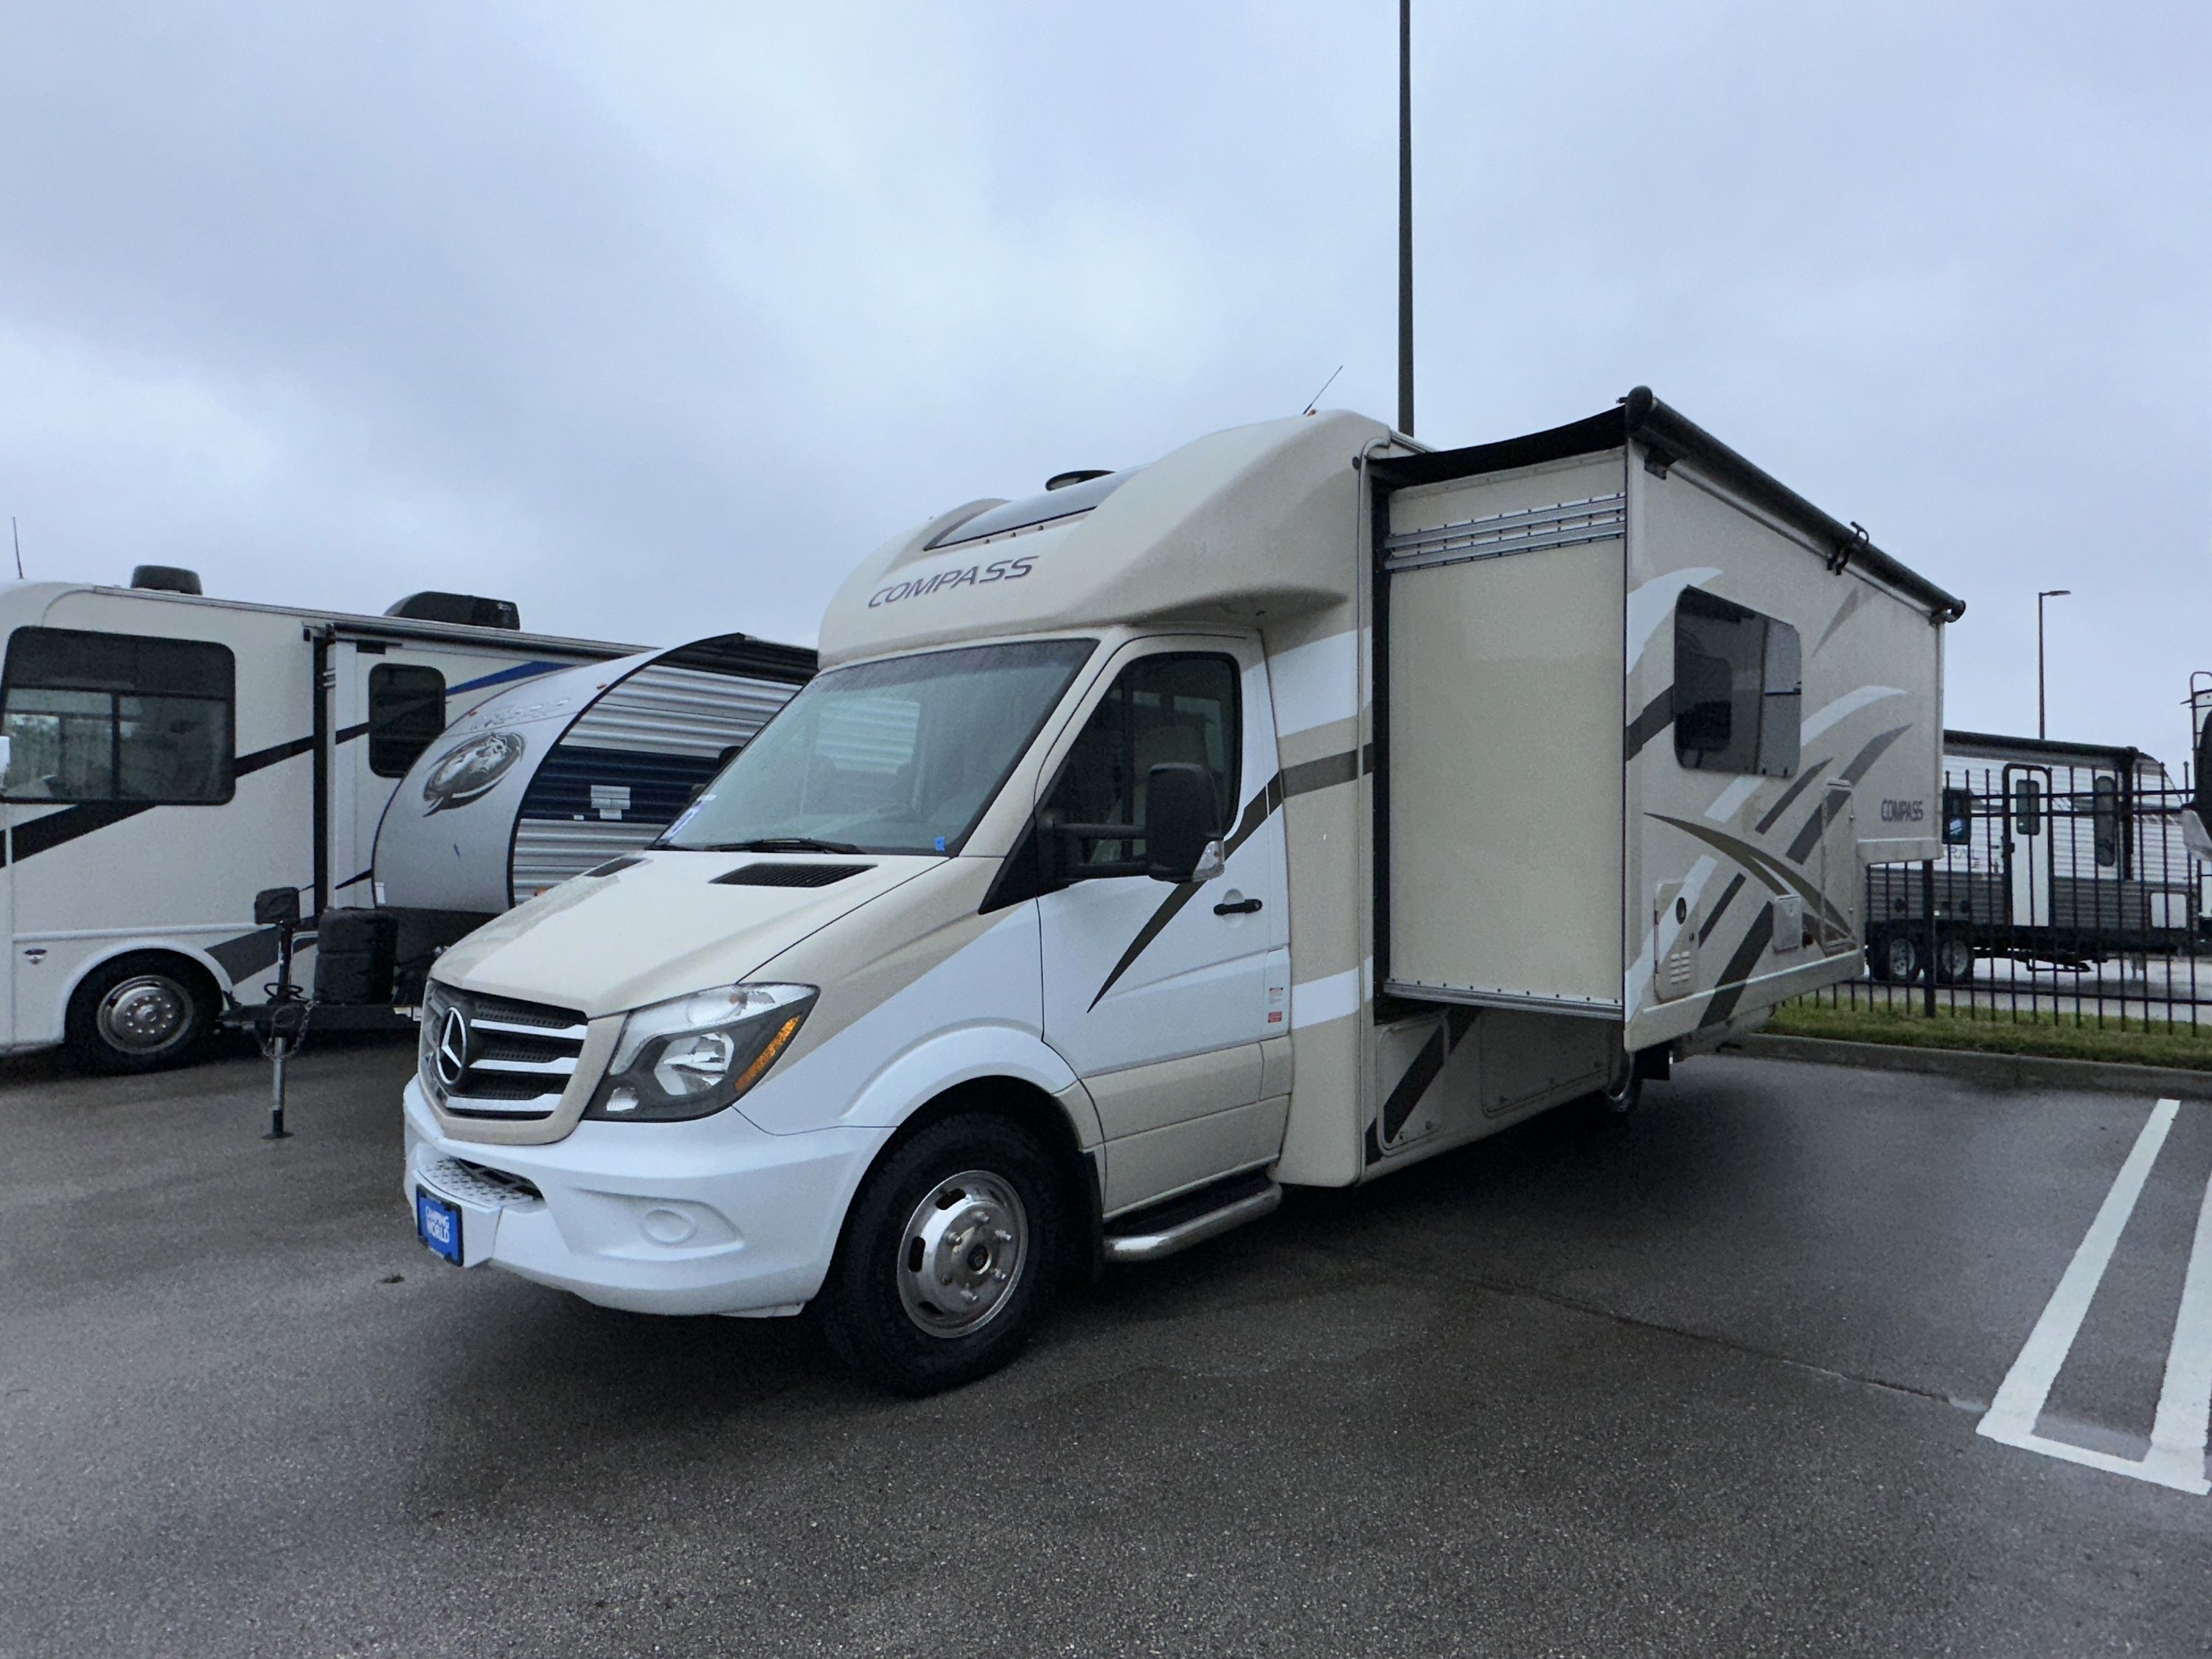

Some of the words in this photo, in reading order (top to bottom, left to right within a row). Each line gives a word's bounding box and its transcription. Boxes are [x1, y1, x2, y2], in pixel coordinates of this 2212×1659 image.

[868, 555, 1040, 608] COMPASS
[1881, 799, 1923, 822] COMPASS
[426, 1217, 450, 1244] WORLD
